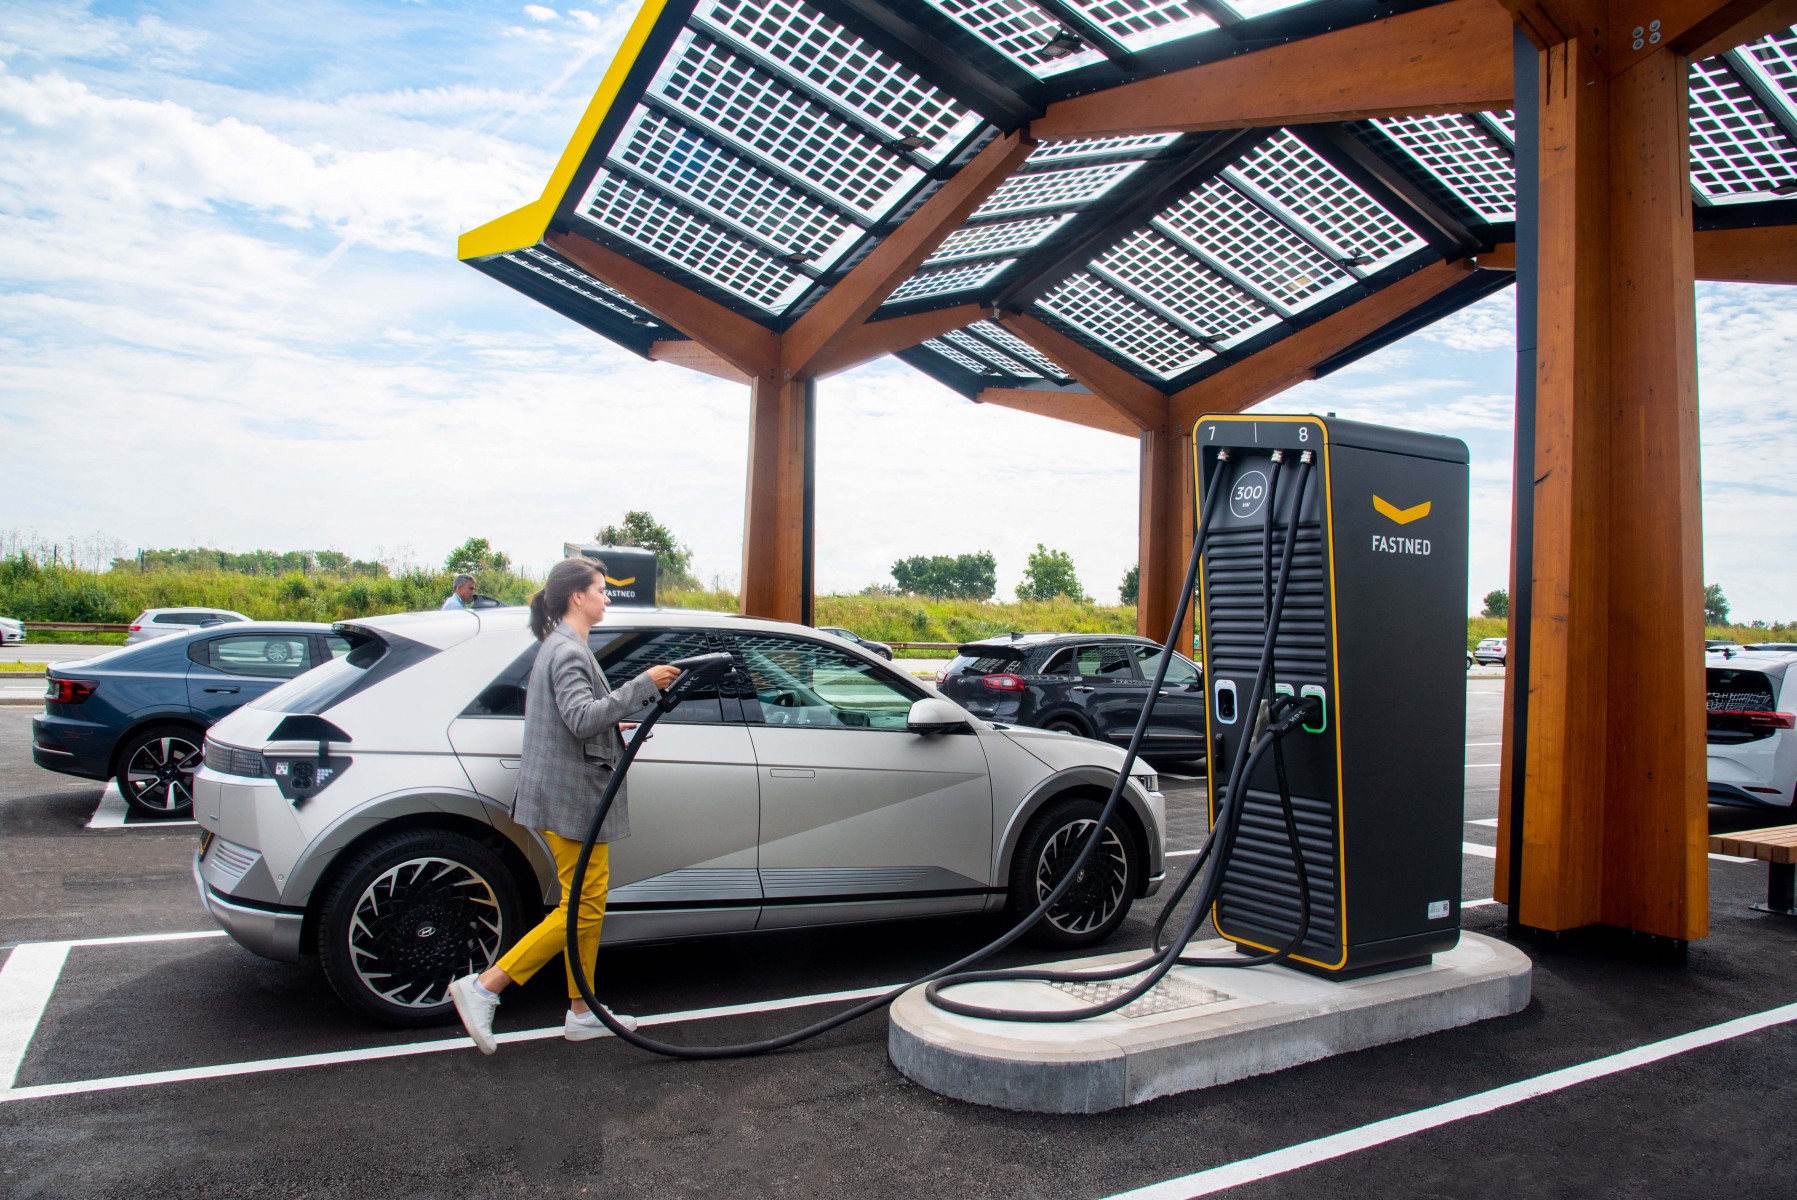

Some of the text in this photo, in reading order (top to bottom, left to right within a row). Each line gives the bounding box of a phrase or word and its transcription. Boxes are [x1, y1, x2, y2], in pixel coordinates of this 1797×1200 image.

[1208, 426, 1309, 442] 7 8
[1235, 485, 1263, 500] 300
[1372, 535, 1431, 556] FASTNED
